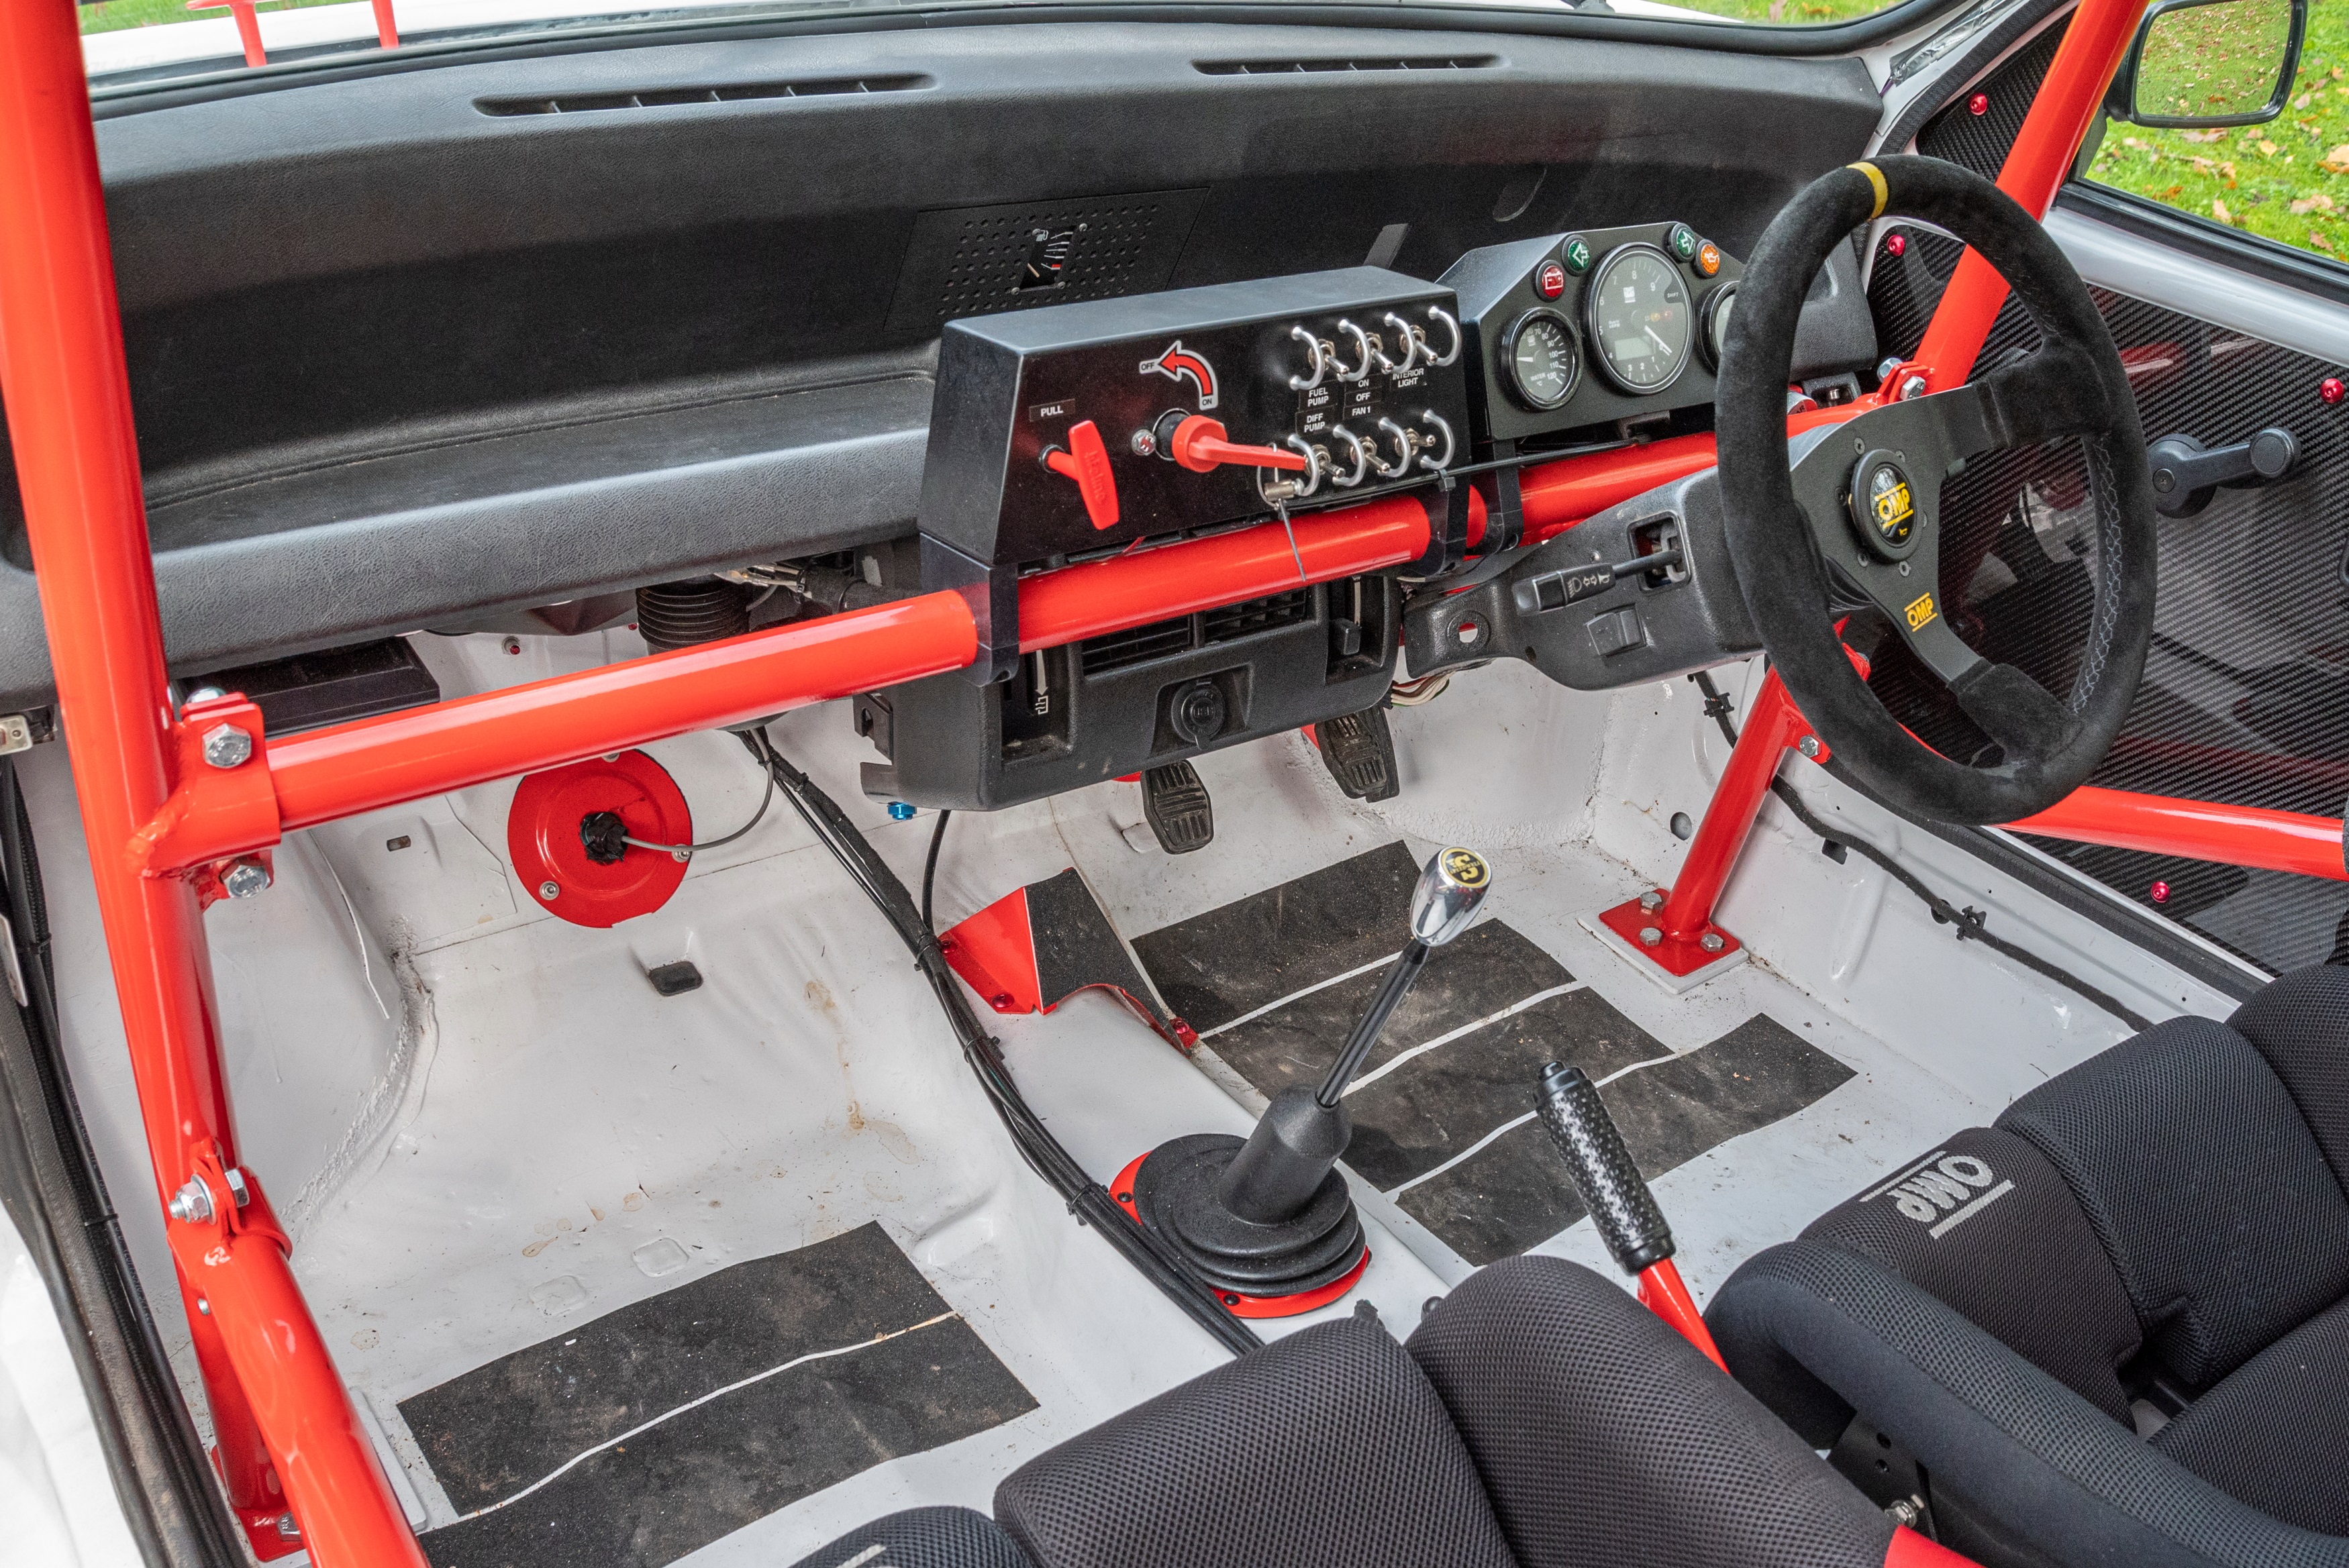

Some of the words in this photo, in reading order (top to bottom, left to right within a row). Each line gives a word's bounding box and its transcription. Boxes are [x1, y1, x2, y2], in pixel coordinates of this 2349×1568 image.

[1632, 270, 1637, 280] 8
[1613, 276, 1617, 285] 7
[1650, 282, 1656, 291] 9
[1599, 325, 1603, 335] 5
[1549, 350, 1558, 358] 100
[1550, 361, 1558, 369] 110
[1392, 368, 1424, 380] INTERIOR
[1530, 373, 1546, 381] WATER
[1547, 372, 1556, 380] 120
[1358, 379, 1370, 388] ON
[1397, 377, 1418, 388] LIGHT
[1309, 387, 1328, 398] FUEL
[1356, 392, 1371, 402] OFF
[1307, 395, 1329, 407] PUMP
[1040, 405, 1063, 417] PULL
[1352, 407, 1366, 416] FAN
[1367, 406, 1371, 414] 1
[1306, 413, 1323, 423] DIFF
[1304, 421, 1326, 433] PUMP
[1879, 488, 1910, 520] OMP
[1907, 598, 1934, 626] OMP
[1887, 1155, 1993, 1222] OMP
